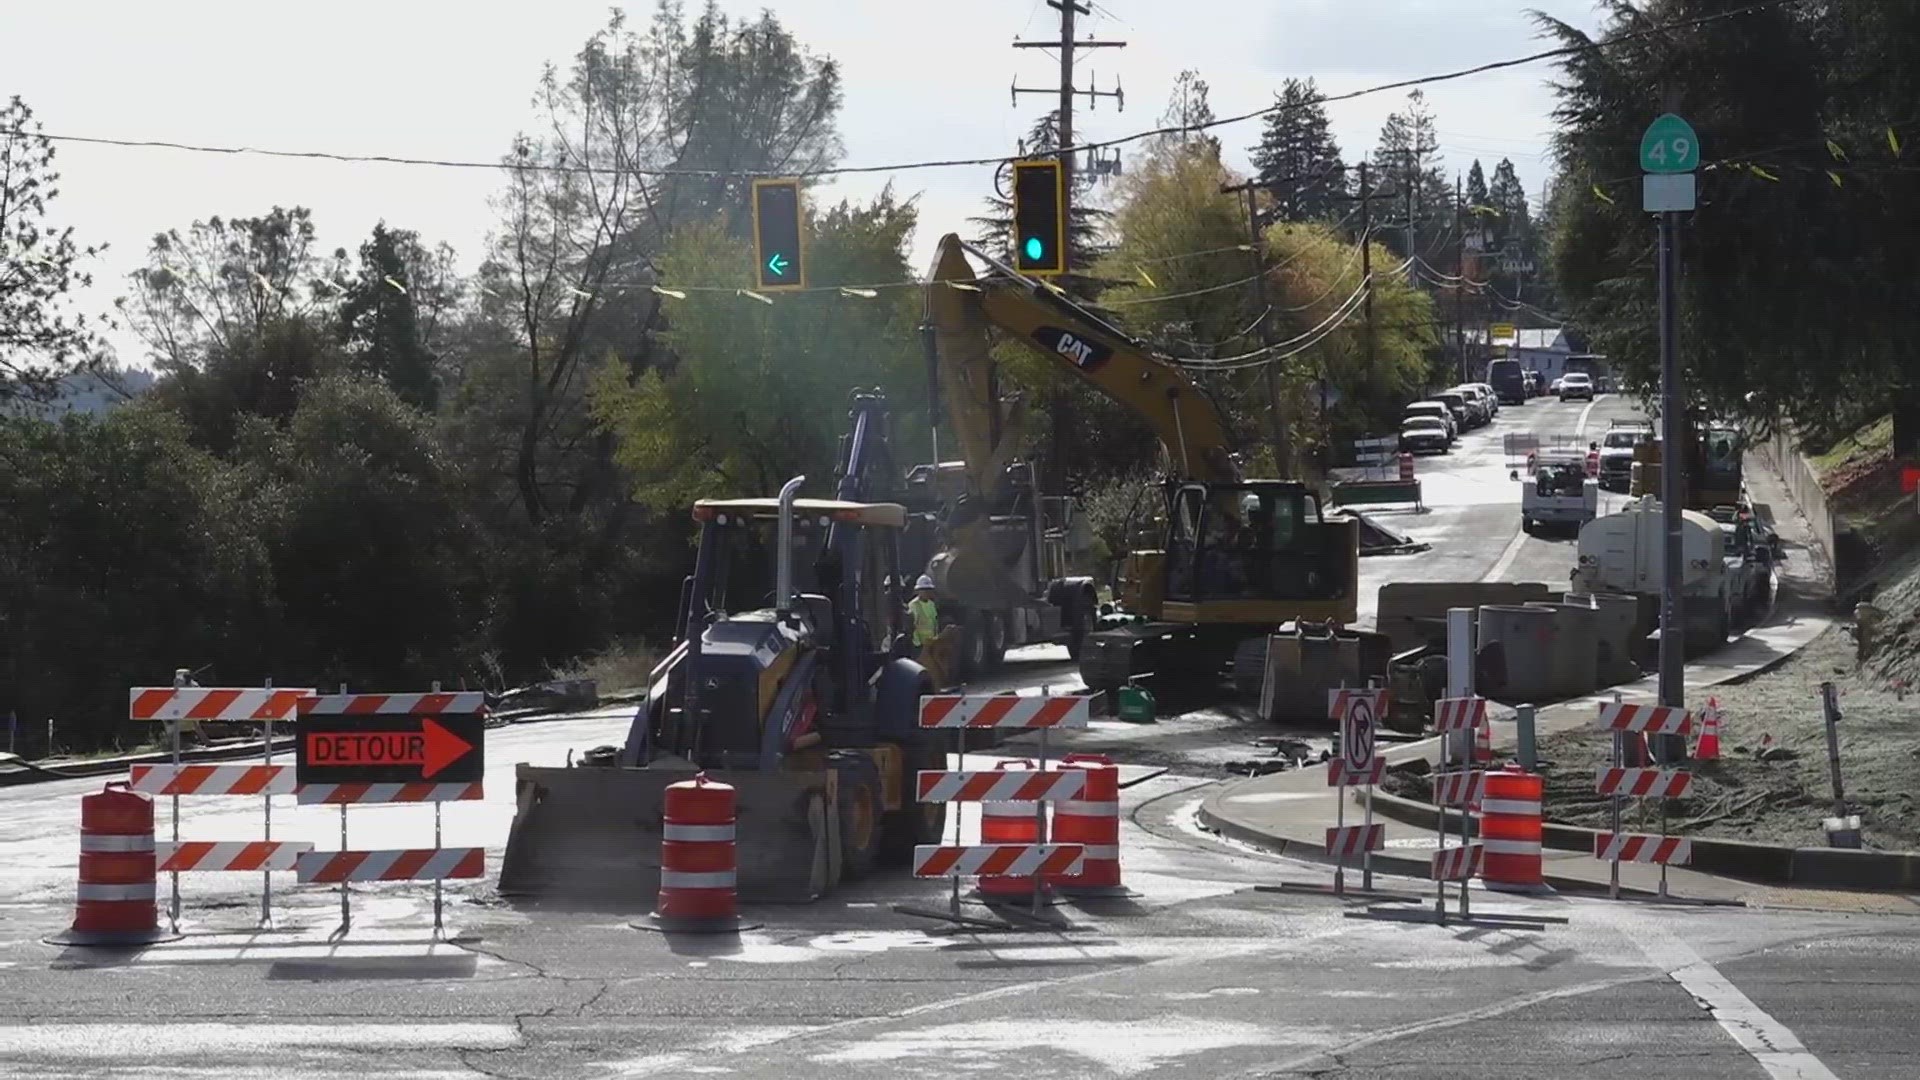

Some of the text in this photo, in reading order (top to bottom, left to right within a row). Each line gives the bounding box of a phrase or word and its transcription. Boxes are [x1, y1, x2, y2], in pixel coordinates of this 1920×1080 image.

[1648, 138, 1690, 165] 49
[1057, 333, 1092, 367] CAT
[314, 735, 424, 761] DETOUR
